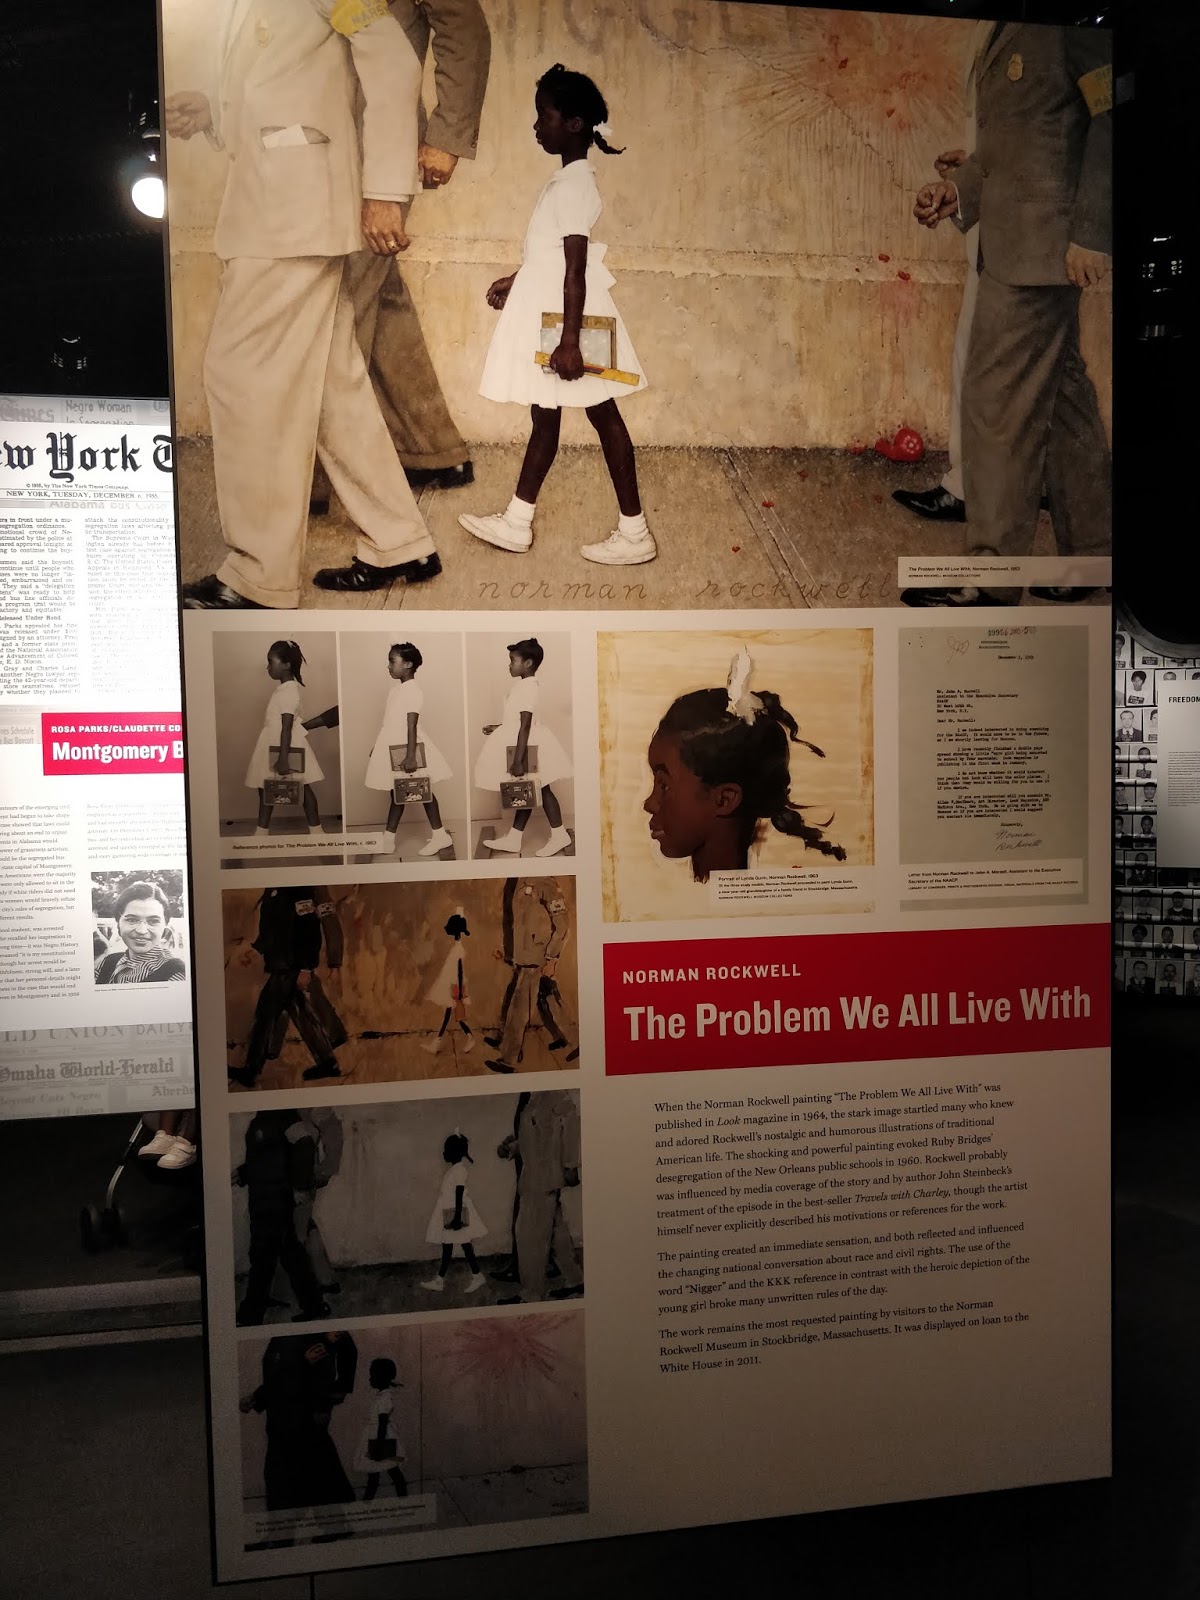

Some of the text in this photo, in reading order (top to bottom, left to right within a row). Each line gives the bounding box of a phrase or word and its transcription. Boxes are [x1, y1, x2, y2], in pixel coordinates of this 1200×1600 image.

[66, 400, 132, 414] Negro Woman
[46, 431, 142, 483] York
[478, 572, 890, 600] norman rockwell
[79, 725, 166, 733] PARKS/CLAUDETTE
[53, 742, 168, 763] Montgomery
[623, 964, 801, 984] NORMAN ROCKWELL
[623, 985, 1091, 1041] The Problem We All Live With
[60, 1057, 174, 1079] World-Herald
[654, 1102, 683, 1112] When
[686, 1101, 702, 1110] the
[704, 1100, 744, 1109] Norman
[747, 1095, 790, 1106] Rockwell
[792, 1093, 832, 1106] painting
[860, 1089, 898, 1100] Problem
[901, 1088, 916, 1097] We
[918, 1086, 931, 1096] All
[934, 1086, 953, 1095] Live
[655, 1100, 1014, 1132] published in Look magazine in 1964, the stark image startled many who knew
[655, 1137, 673, 1148] and
[676, 1135, 709, 1146] adored
[764, 1129, 806, 1141] nostalgic
[808, 1127, 826, 1137] and
[829, 1127, 876, 1136] humorous
[879, 1122, 933, 1132] illustrations
[935, 1120, 946, 1129] of
[947, 1116, 994, 1128] traditional
[658, 1329, 678, 1338] The
[680, 1326, 704, 1336] work
[707, 1323, 745, 1334] remains
[748, 1321, 763, 1330] the
[766, 1319, 788, 1328] most
[792, 1313, 836, 1327] requested
[839, 1310, 877, 1324] painting
[880, 1309, 890, 1319] by
[893, 1307, 926, 1316] visitors
[940, 1303, 954, 1312] the
[957, 1301, 993, 1310] Norman
[660, 1343, 703, 1356] Rockwell
[706, 1341, 747, 1351] Museum
[750, 1339, 759, 1347] in
[762, 1333, 820, 1345] Stockbridge,
[823, 1327, 892, 1340] Massachusetts.
[894, 1324, 902, 1333] It
[924, 1318, 966, 1331] displayed
[982, 1316, 1001, 1324] loan
[1015, 1312, 1029, 1321] the
[660, 1356, 761, 1372] White House in 2011.
